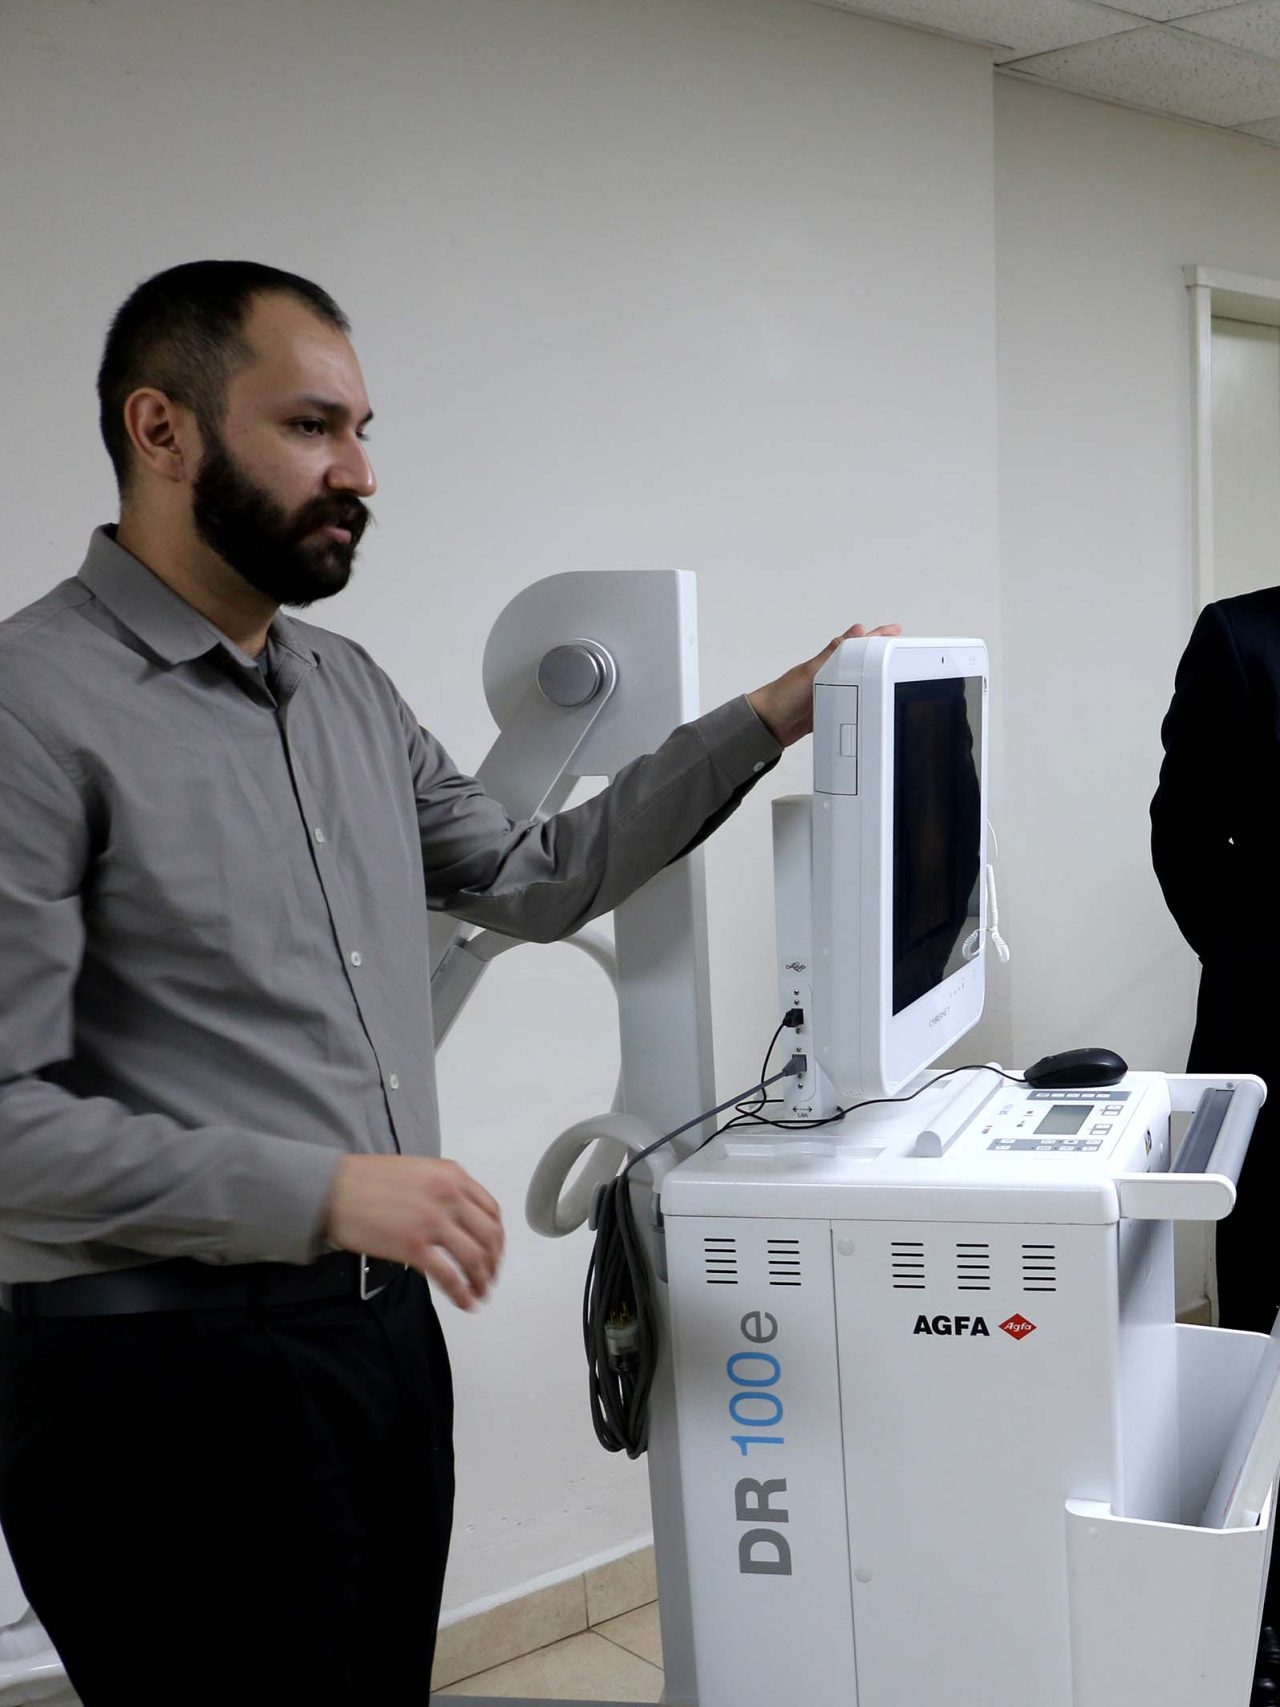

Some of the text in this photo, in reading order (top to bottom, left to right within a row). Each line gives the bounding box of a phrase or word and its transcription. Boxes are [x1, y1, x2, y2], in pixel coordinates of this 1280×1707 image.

[913, 1315, 1032, 1336] AGFA Agfa
[734, 1477, 792, 1576] DR
